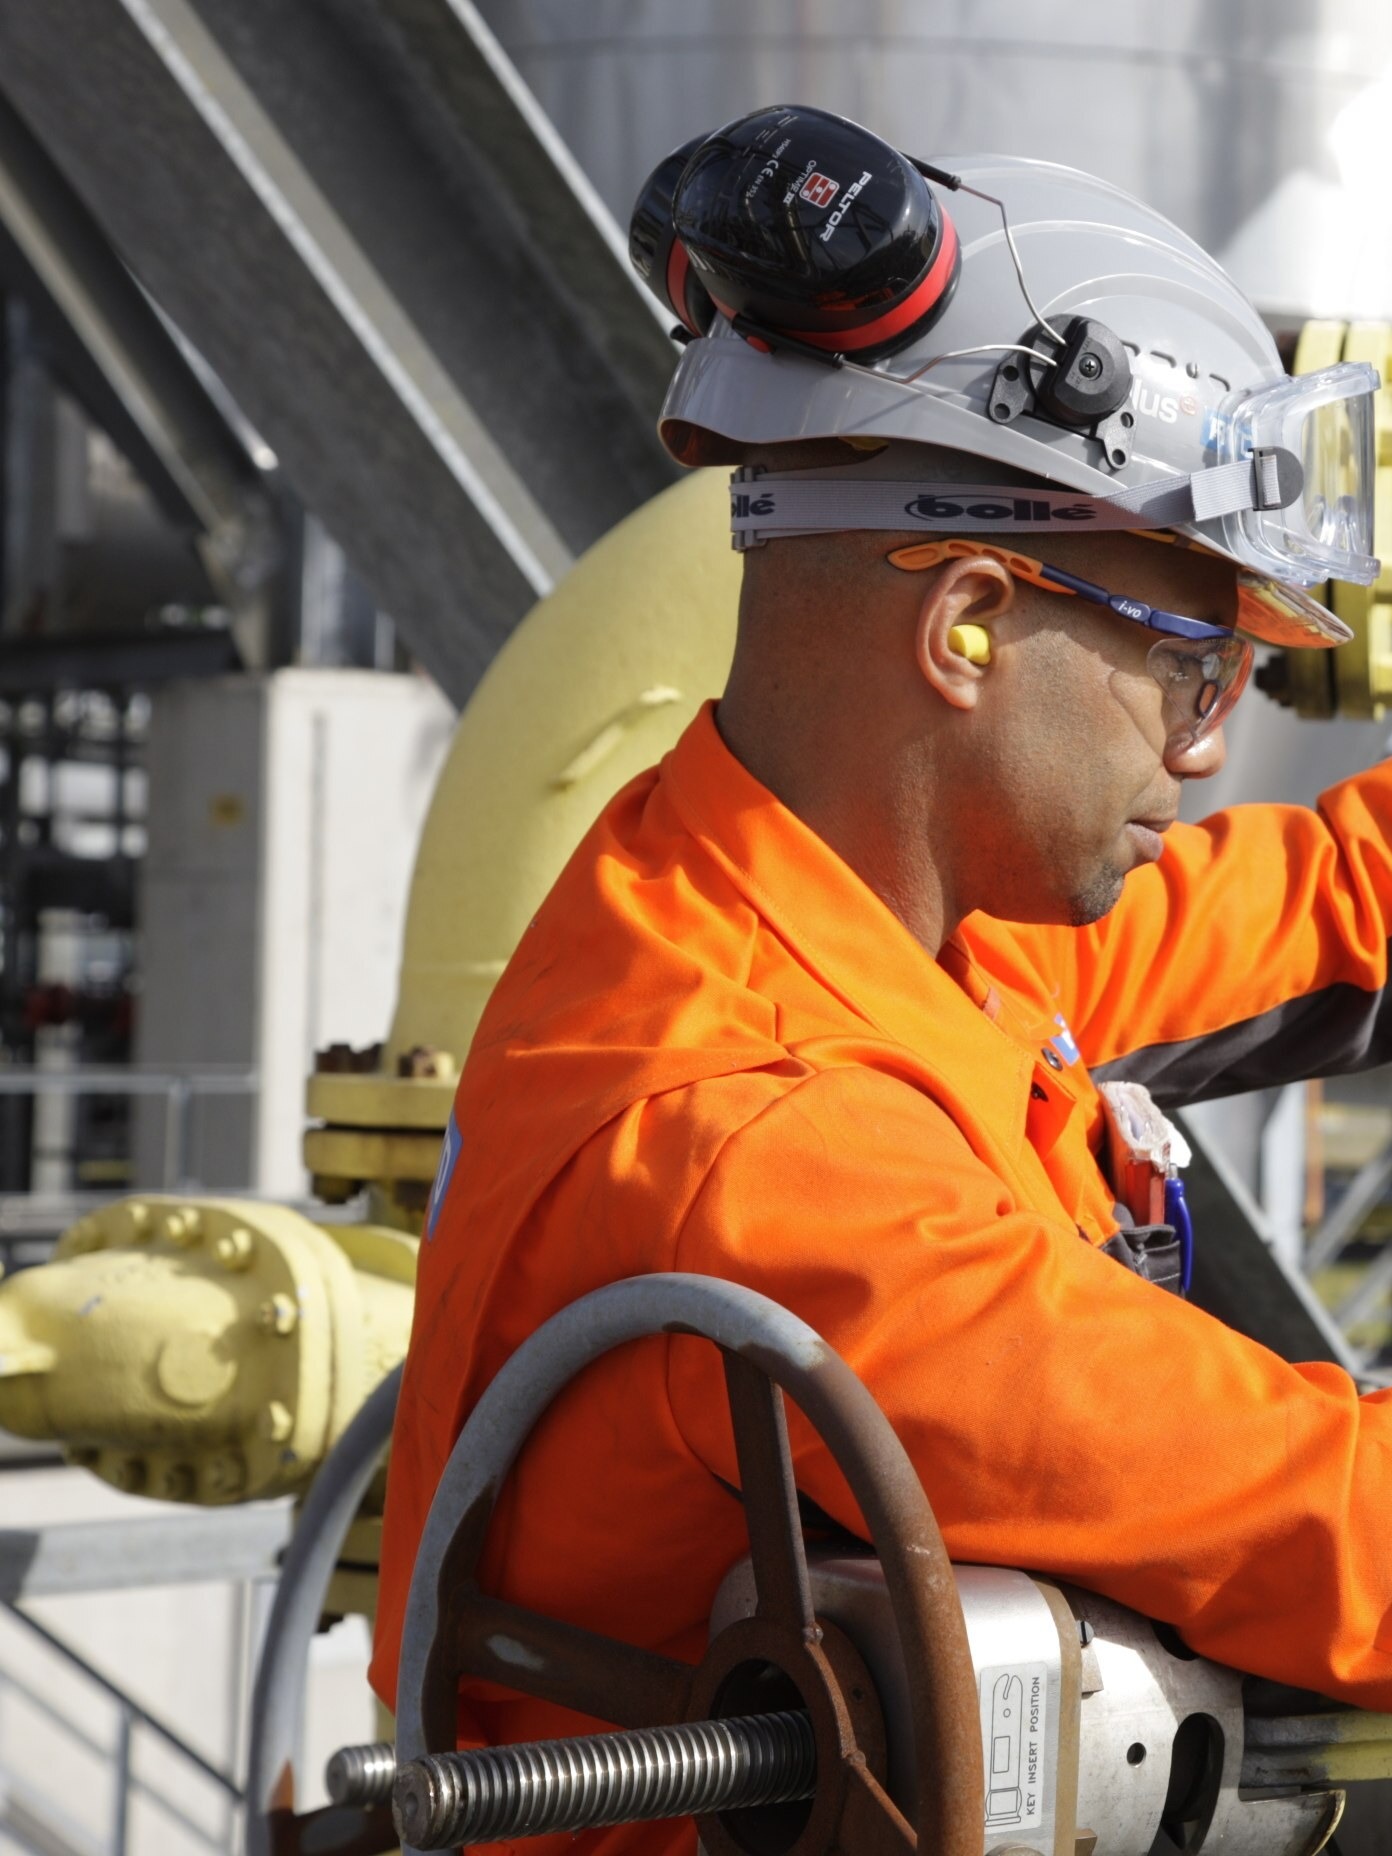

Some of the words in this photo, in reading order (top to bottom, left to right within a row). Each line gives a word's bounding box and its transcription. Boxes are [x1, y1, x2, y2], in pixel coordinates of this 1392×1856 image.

[790, 159, 817, 193] OPTIME
[819, 170, 873, 242] PELTOR
[916, 494, 1098, 521] bollé
[1118, 600, 1142, 618] i-vo
[1029, 1676, 1040, 1734] POSITION
[1027, 1741, 1038, 1785] INSERT
[1026, 1792, 1036, 1816] KEY
